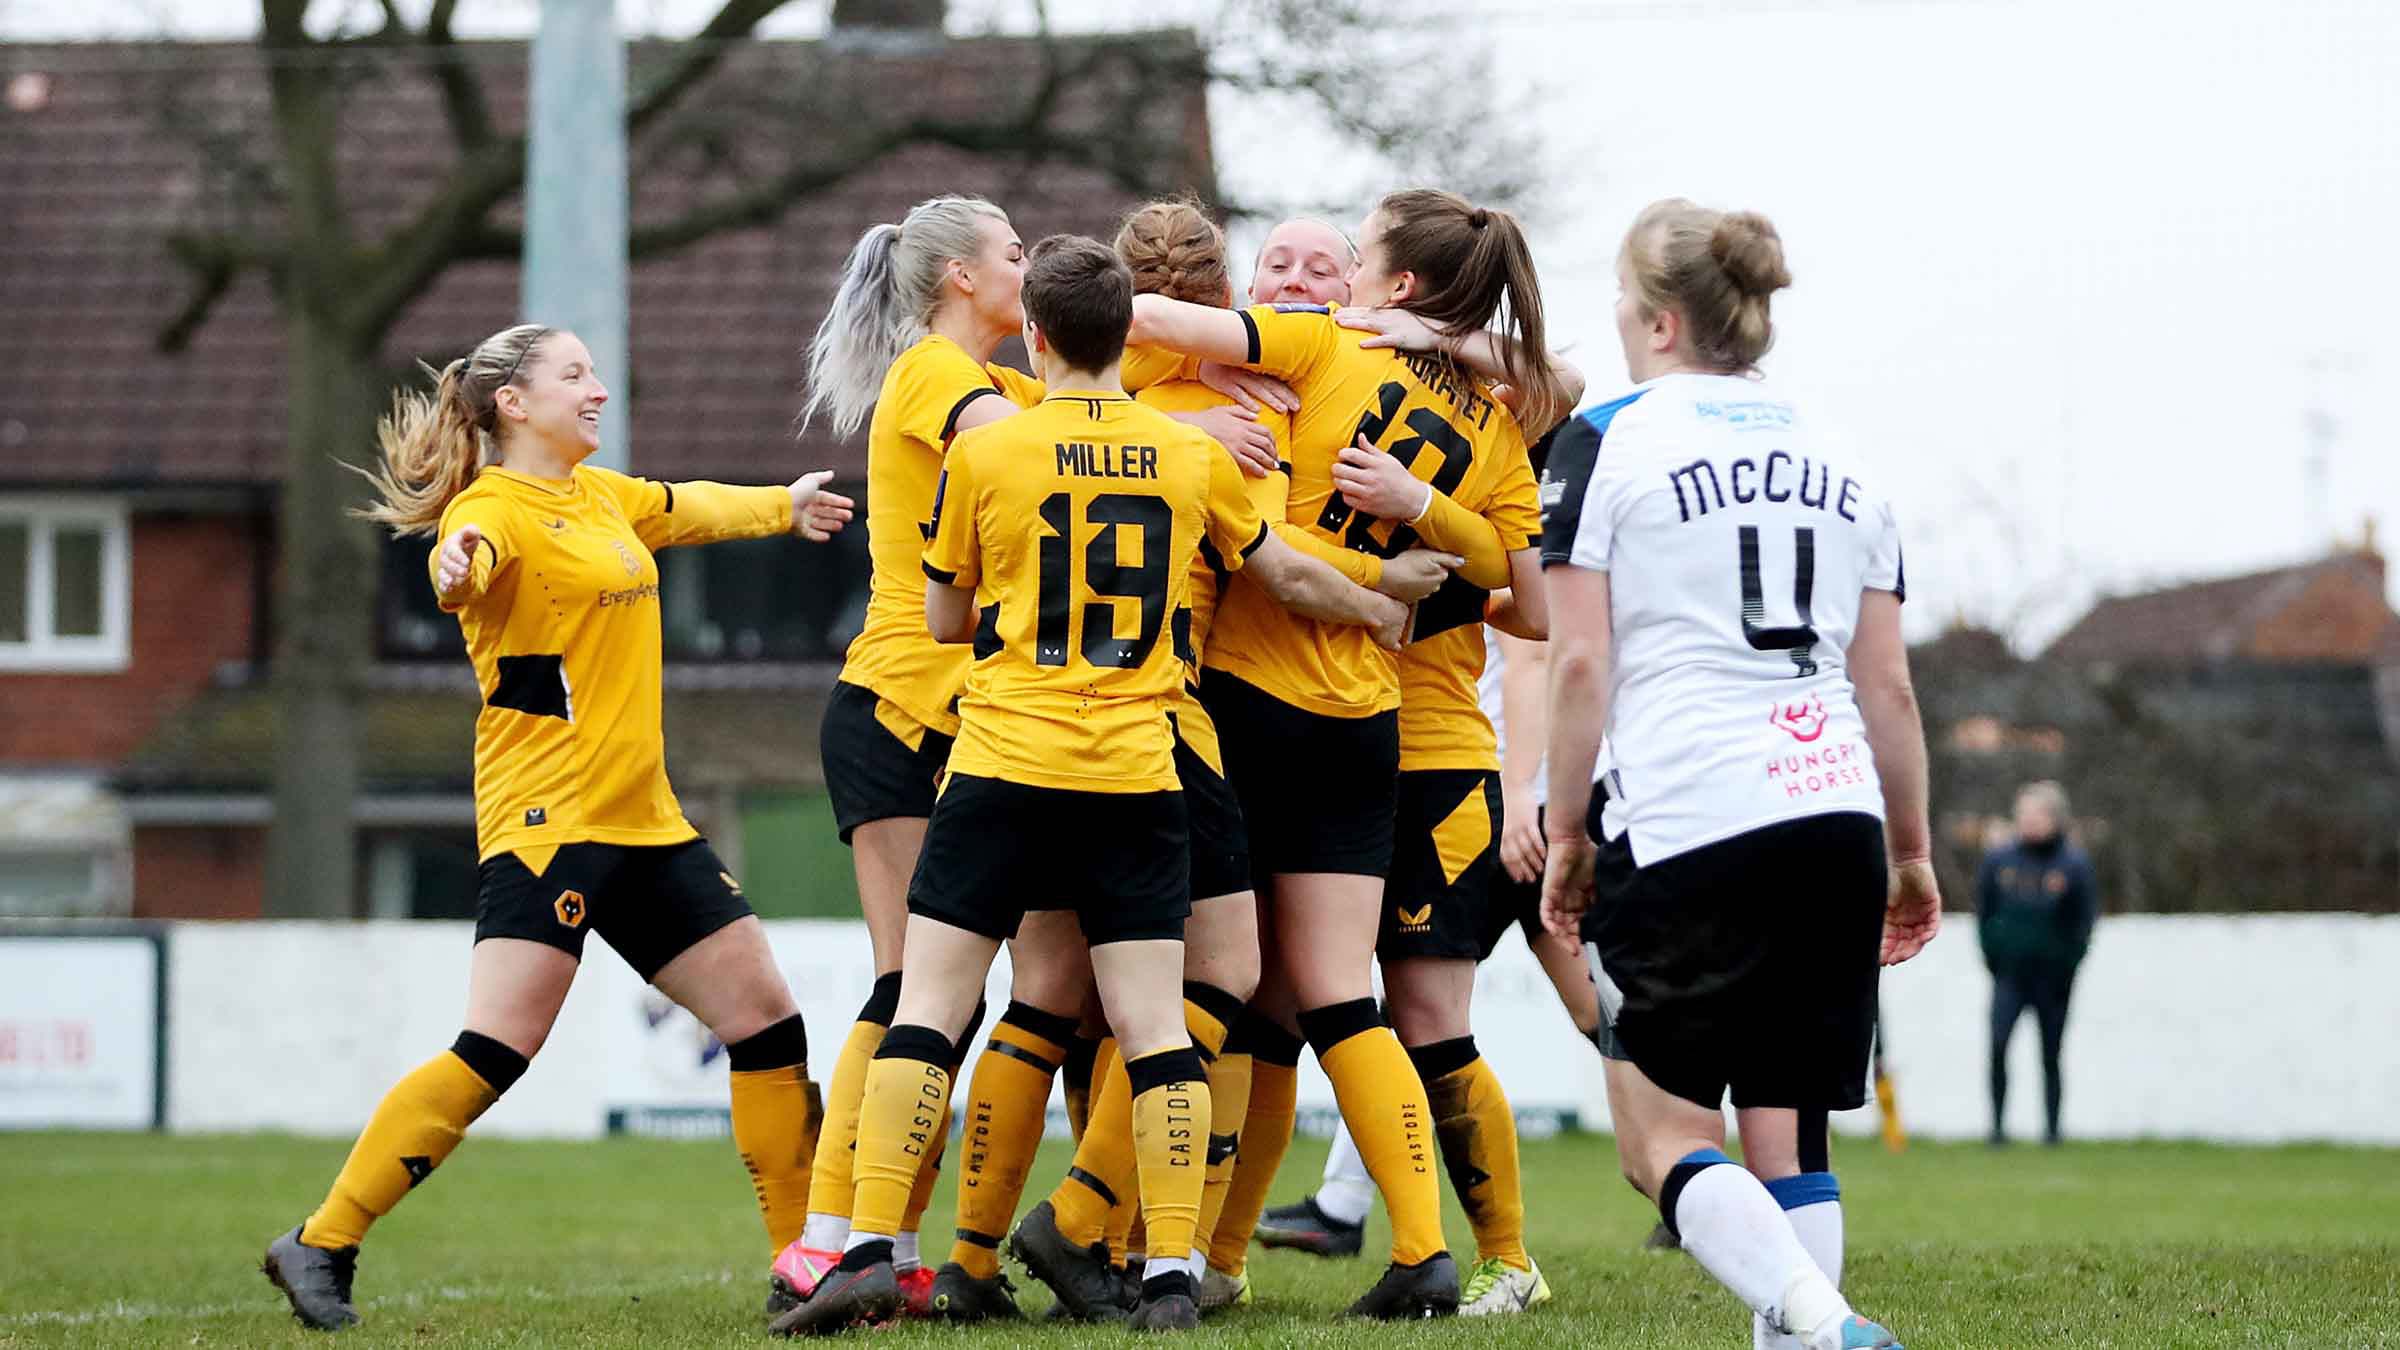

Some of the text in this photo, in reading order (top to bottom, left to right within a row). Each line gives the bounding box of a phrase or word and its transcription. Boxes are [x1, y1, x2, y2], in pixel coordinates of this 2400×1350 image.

[1055, 443, 1158, 479] MILLER
[1036, 492, 1173, 669] 19
[1738, 525, 1820, 678] 4
[1785, 766, 1864, 797] HORSE
[967, 1101, 992, 1187] CASTORE
[1402, 1102, 1426, 1173] CASTORE
